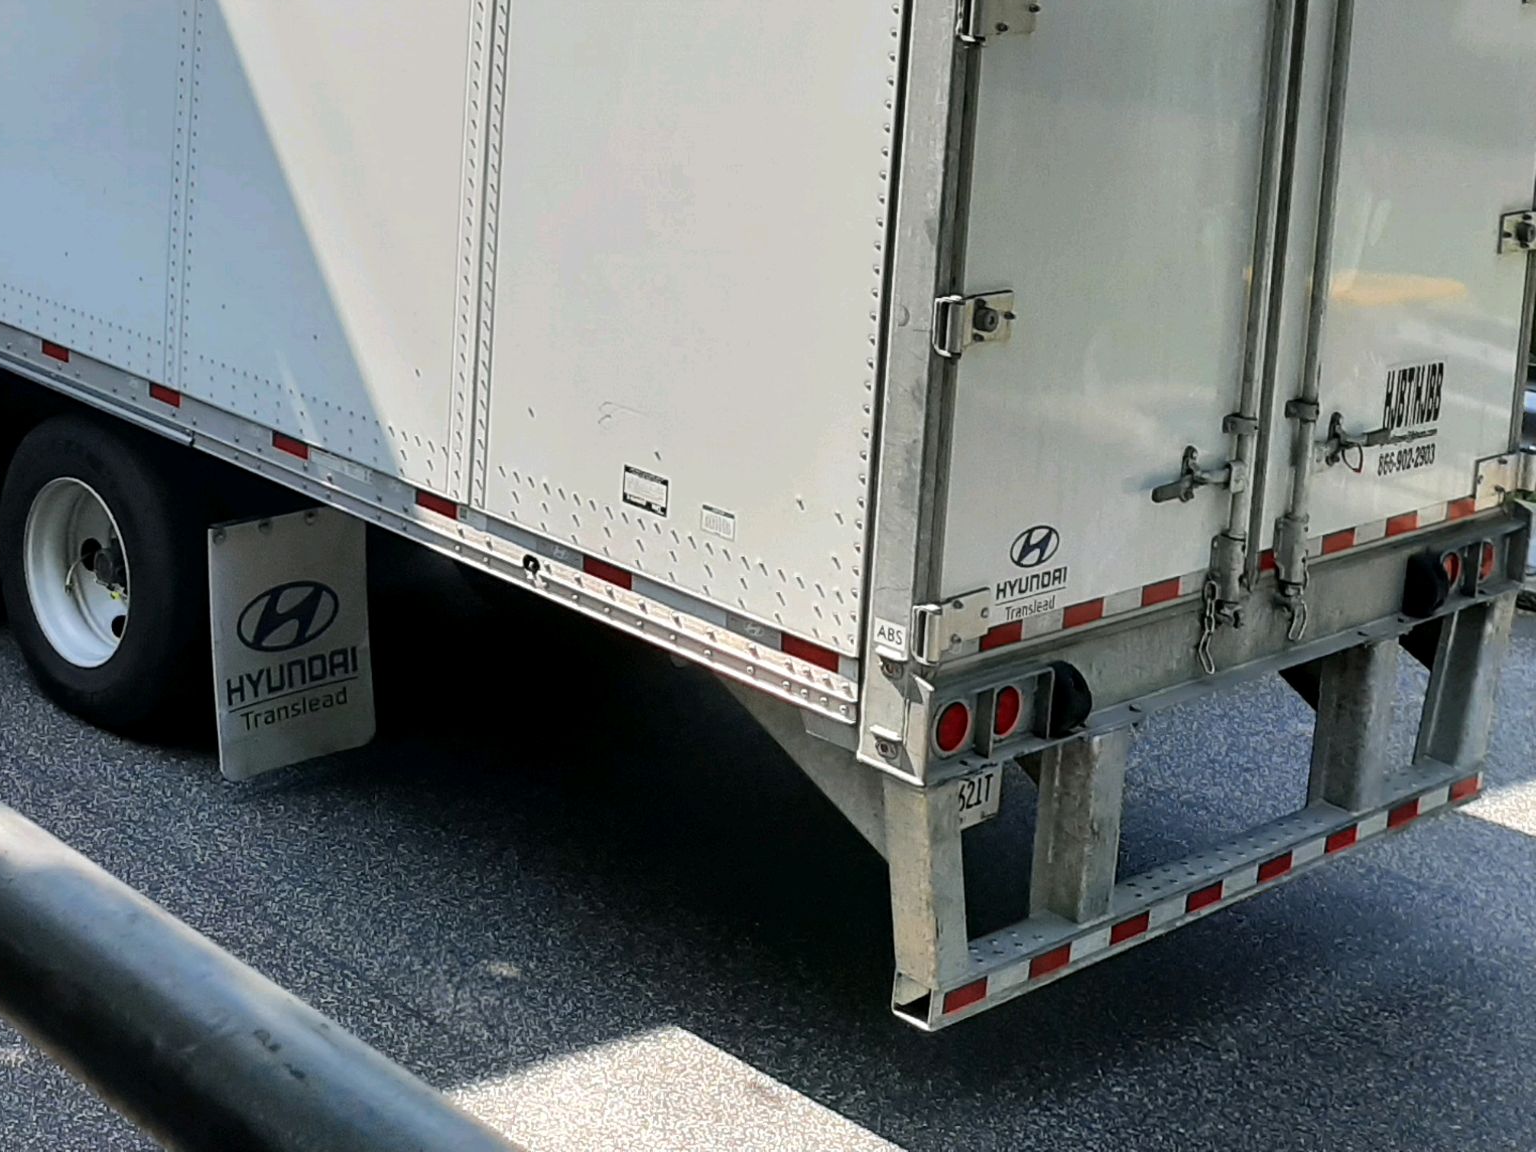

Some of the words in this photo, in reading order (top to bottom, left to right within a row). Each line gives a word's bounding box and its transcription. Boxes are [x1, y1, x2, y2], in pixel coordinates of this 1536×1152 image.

[995, 566, 1068, 600] HYUNDAI
[1005, 595, 1056, 621] Translead
[877, 624, 903, 646] ABS
[226, 645, 359, 706] HYUNDAI
[240, 687, 349, 731] Translead
